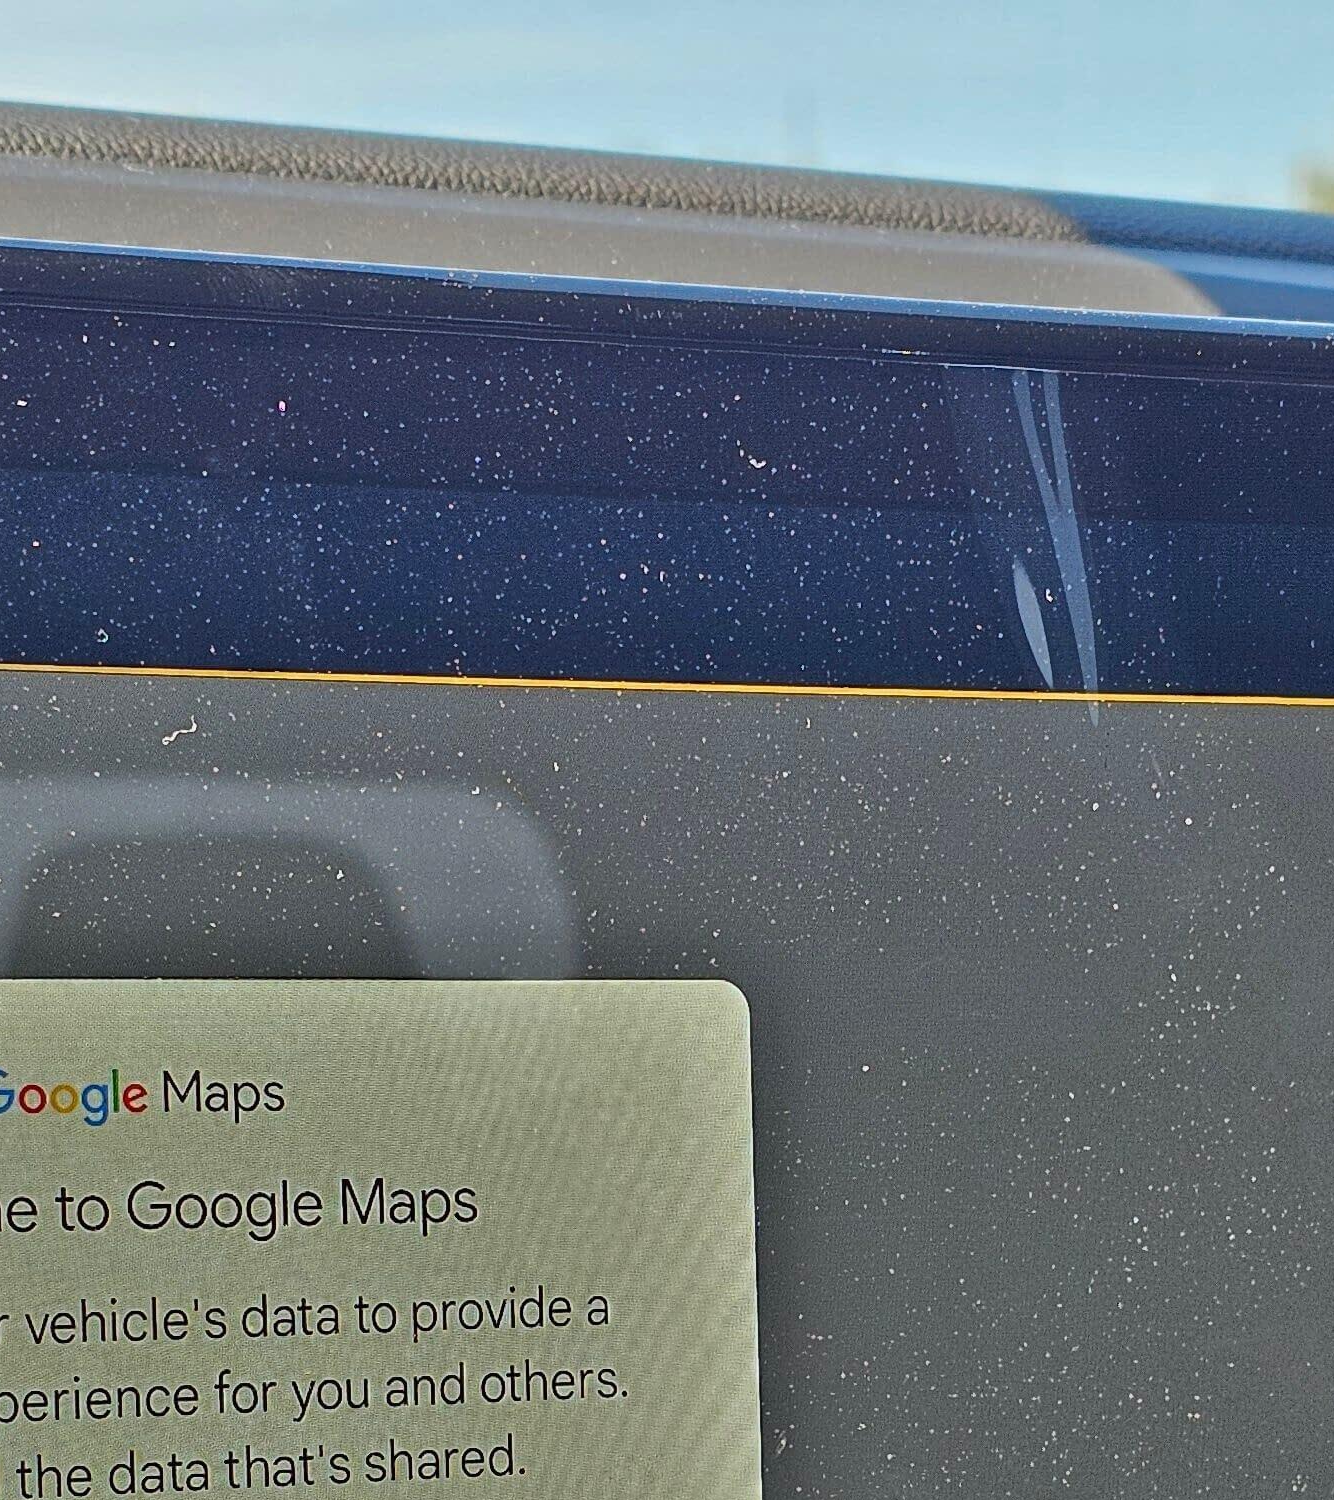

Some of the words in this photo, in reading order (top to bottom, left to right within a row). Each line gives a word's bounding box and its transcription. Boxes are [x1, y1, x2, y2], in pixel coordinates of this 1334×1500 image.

[164, 1071, 285, 1125] Maps
[55, 1187, 109, 1232] to
[128, 1180, 322, 1241] Google
[343, 1179, 478, 1238] Maps
[25, 1297, 227, 1345] vehicle's
[242, 1294, 340, 1338] data
[355, 1296, 396, 1334] to
[413, 1285, 571, 1343] provide
[587, 1295, 609, 1326] a
[215, 1368, 277, 1414] for
[291, 1376, 369, 1423] you
[387, 1362, 464, 1408] and
[481, 1357, 628, 1404] others.
[16, 1453, 93, 1499] the
[109, 1450, 208, 1494] data
[224, 1443, 351, 1490] that's
[366, 1432, 526, 1483] shared.
